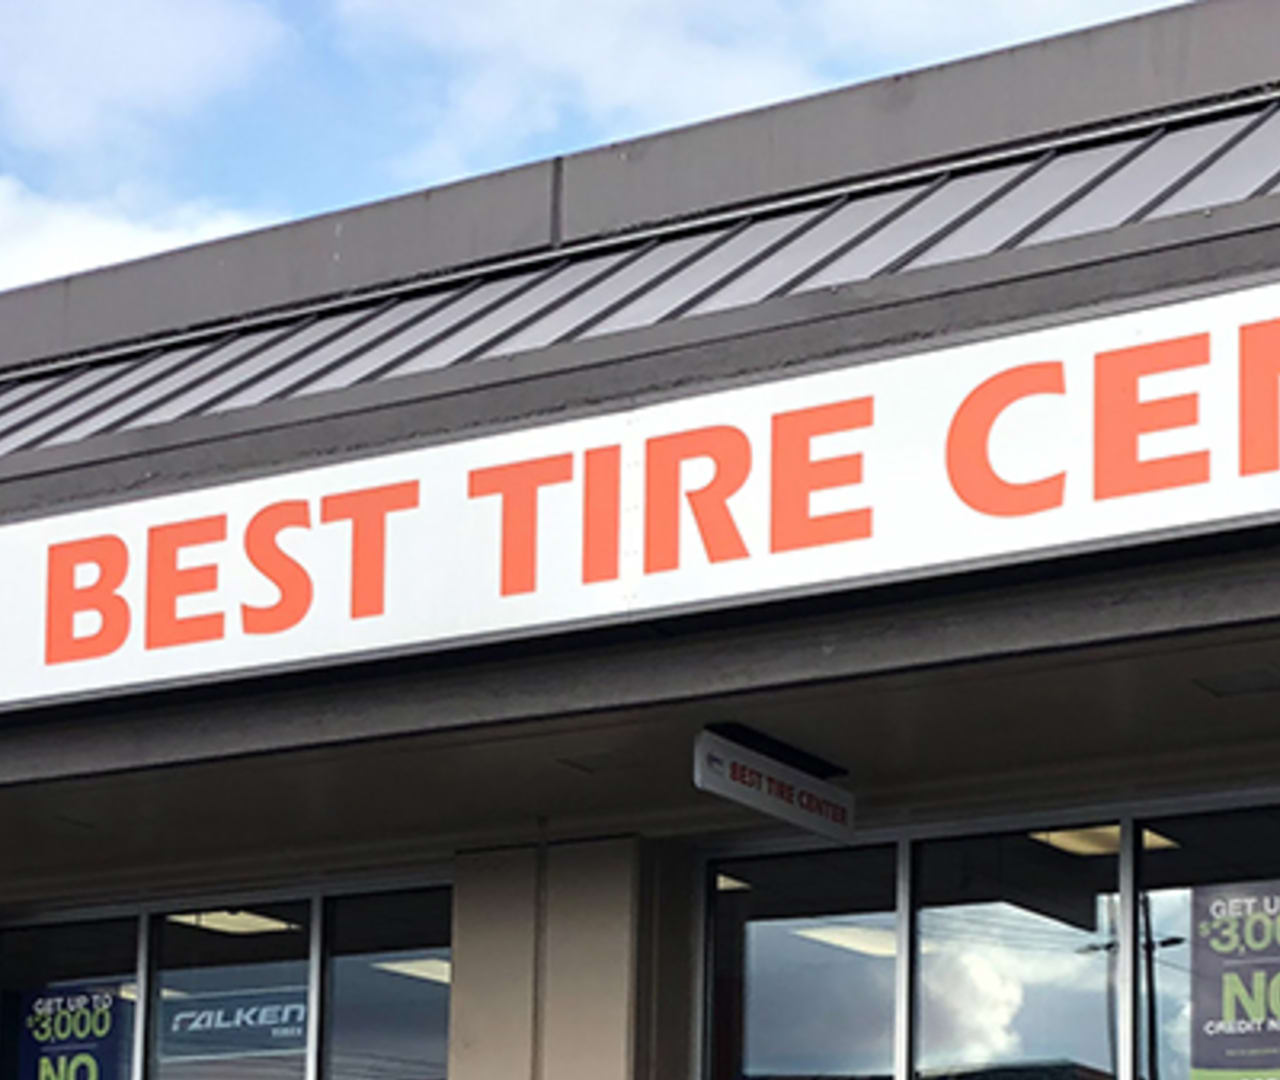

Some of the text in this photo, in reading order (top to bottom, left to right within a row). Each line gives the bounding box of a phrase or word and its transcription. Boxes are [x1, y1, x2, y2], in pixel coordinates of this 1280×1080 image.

[46, 480, 419, 664] BEST
[469, 397, 873, 596] TIRE
[730, 761, 848, 826] BEST TIRE CENTER
[1209, 898, 1258, 919] GET
[33, 992, 113, 1014] GET UP TO
[172, 1004, 305, 1032] FALKEN
[1203, 1020, 1265, 1036] CREDIT
